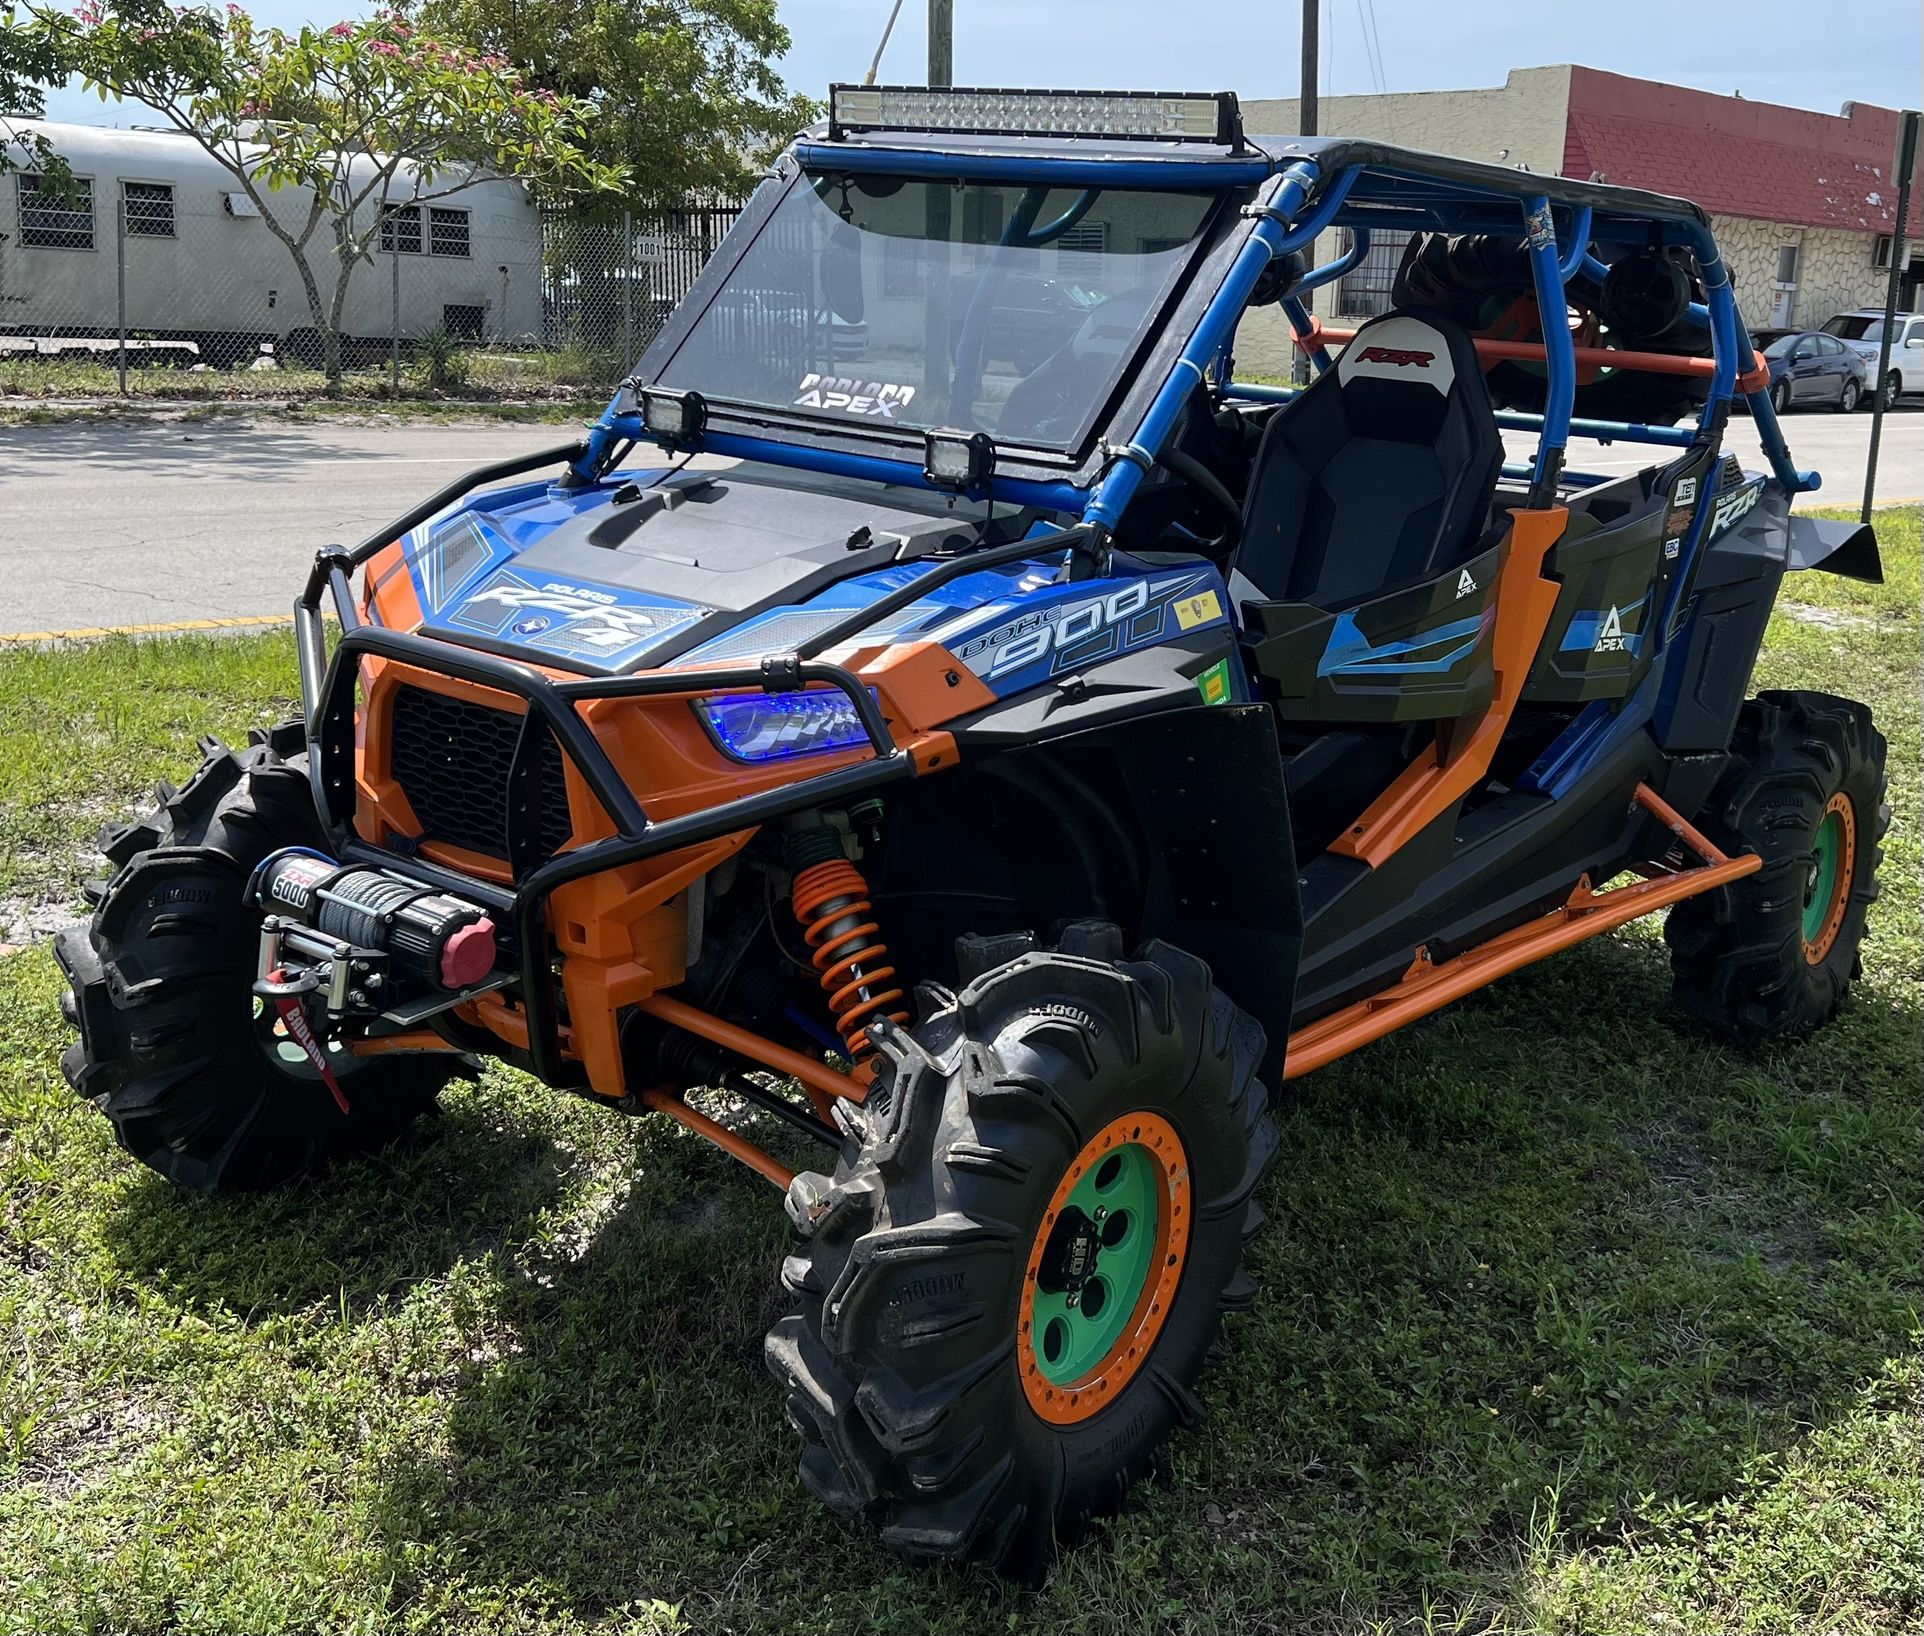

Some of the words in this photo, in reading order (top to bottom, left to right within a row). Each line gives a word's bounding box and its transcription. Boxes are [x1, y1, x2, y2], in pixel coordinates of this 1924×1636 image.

[640, 242, 660, 256] 1001
[1354, 346, 1436, 368] RZR
[793, 389, 900, 418] APEX
[1708, 485, 1758, 540] RZR
[541, 583, 618, 605] POLARIS
[1455, 581, 1478, 600] APEX
[464, 586, 656, 632] RZR
[570, 627, 640, 647] 4
[959, 604, 1062, 661] DOHC
[987, 579, 1150, 680] 900
[1594, 637, 1626, 652] APEX
[282, 867, 317, 888] ZXR
[273, 878, 310, 908] 5000
[286, 1007, 326, 1071] BADLAND
